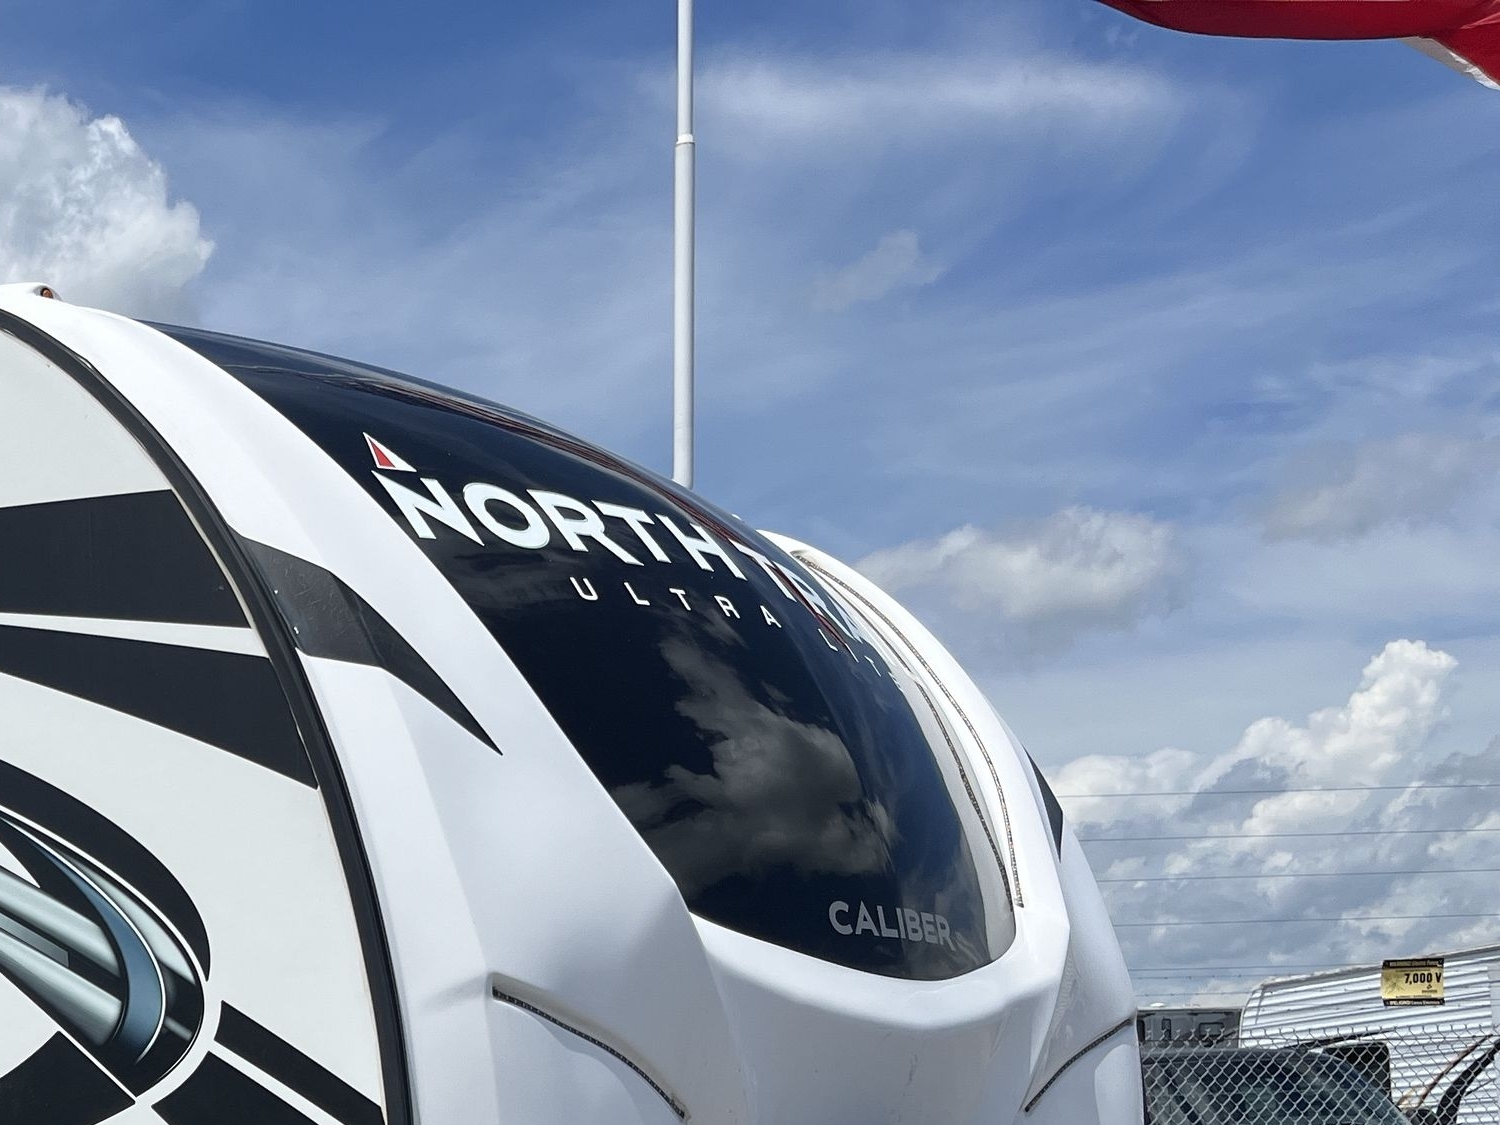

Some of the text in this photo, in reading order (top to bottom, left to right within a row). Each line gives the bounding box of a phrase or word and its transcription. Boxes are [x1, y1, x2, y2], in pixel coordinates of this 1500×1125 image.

[371, 470, 747, 581] NORTH
[570, 577, 782, 629] ULTRA
[828, 900, 956, 951] CALIBER
[1404, 972, 1442, 985] 7,000 V
